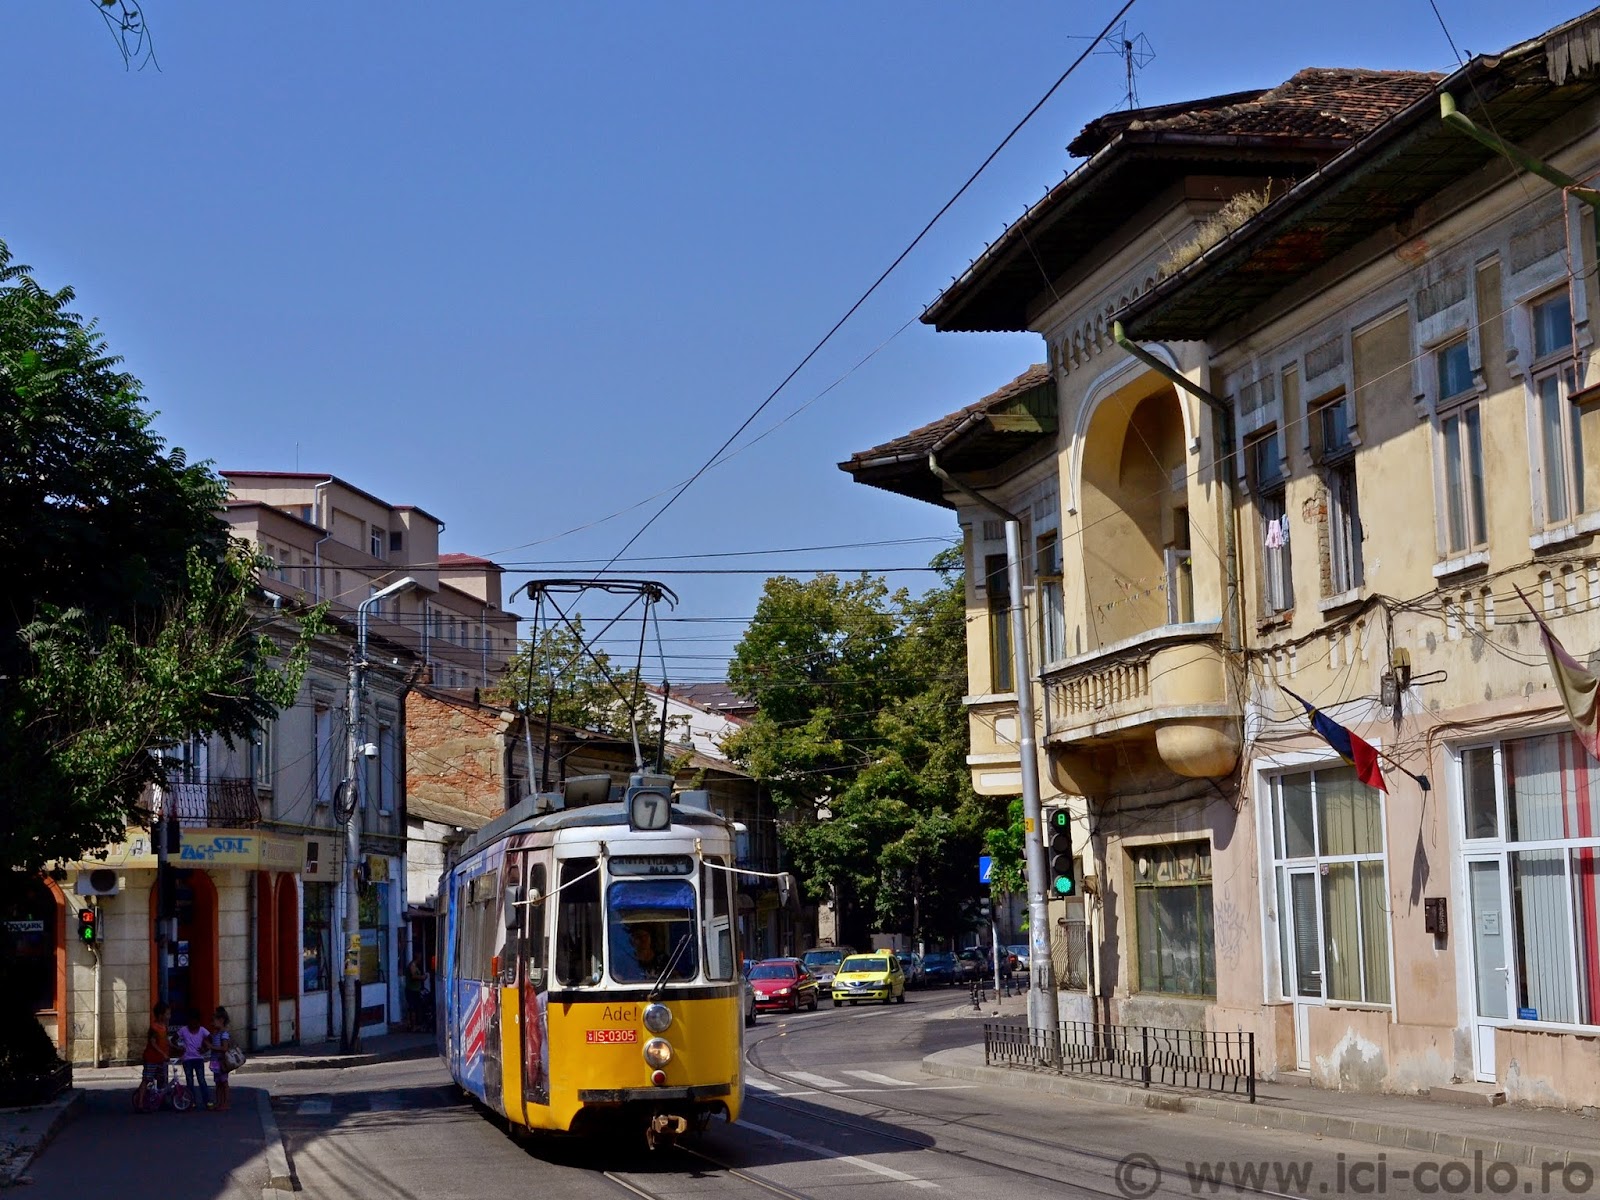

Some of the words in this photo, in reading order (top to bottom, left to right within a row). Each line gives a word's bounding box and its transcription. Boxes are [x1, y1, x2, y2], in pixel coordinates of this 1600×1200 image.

[644, 801, 658, 827] 7
[1058, 813, 1065, 826] 8
[602, 1006, 637, 1021] Ade!
